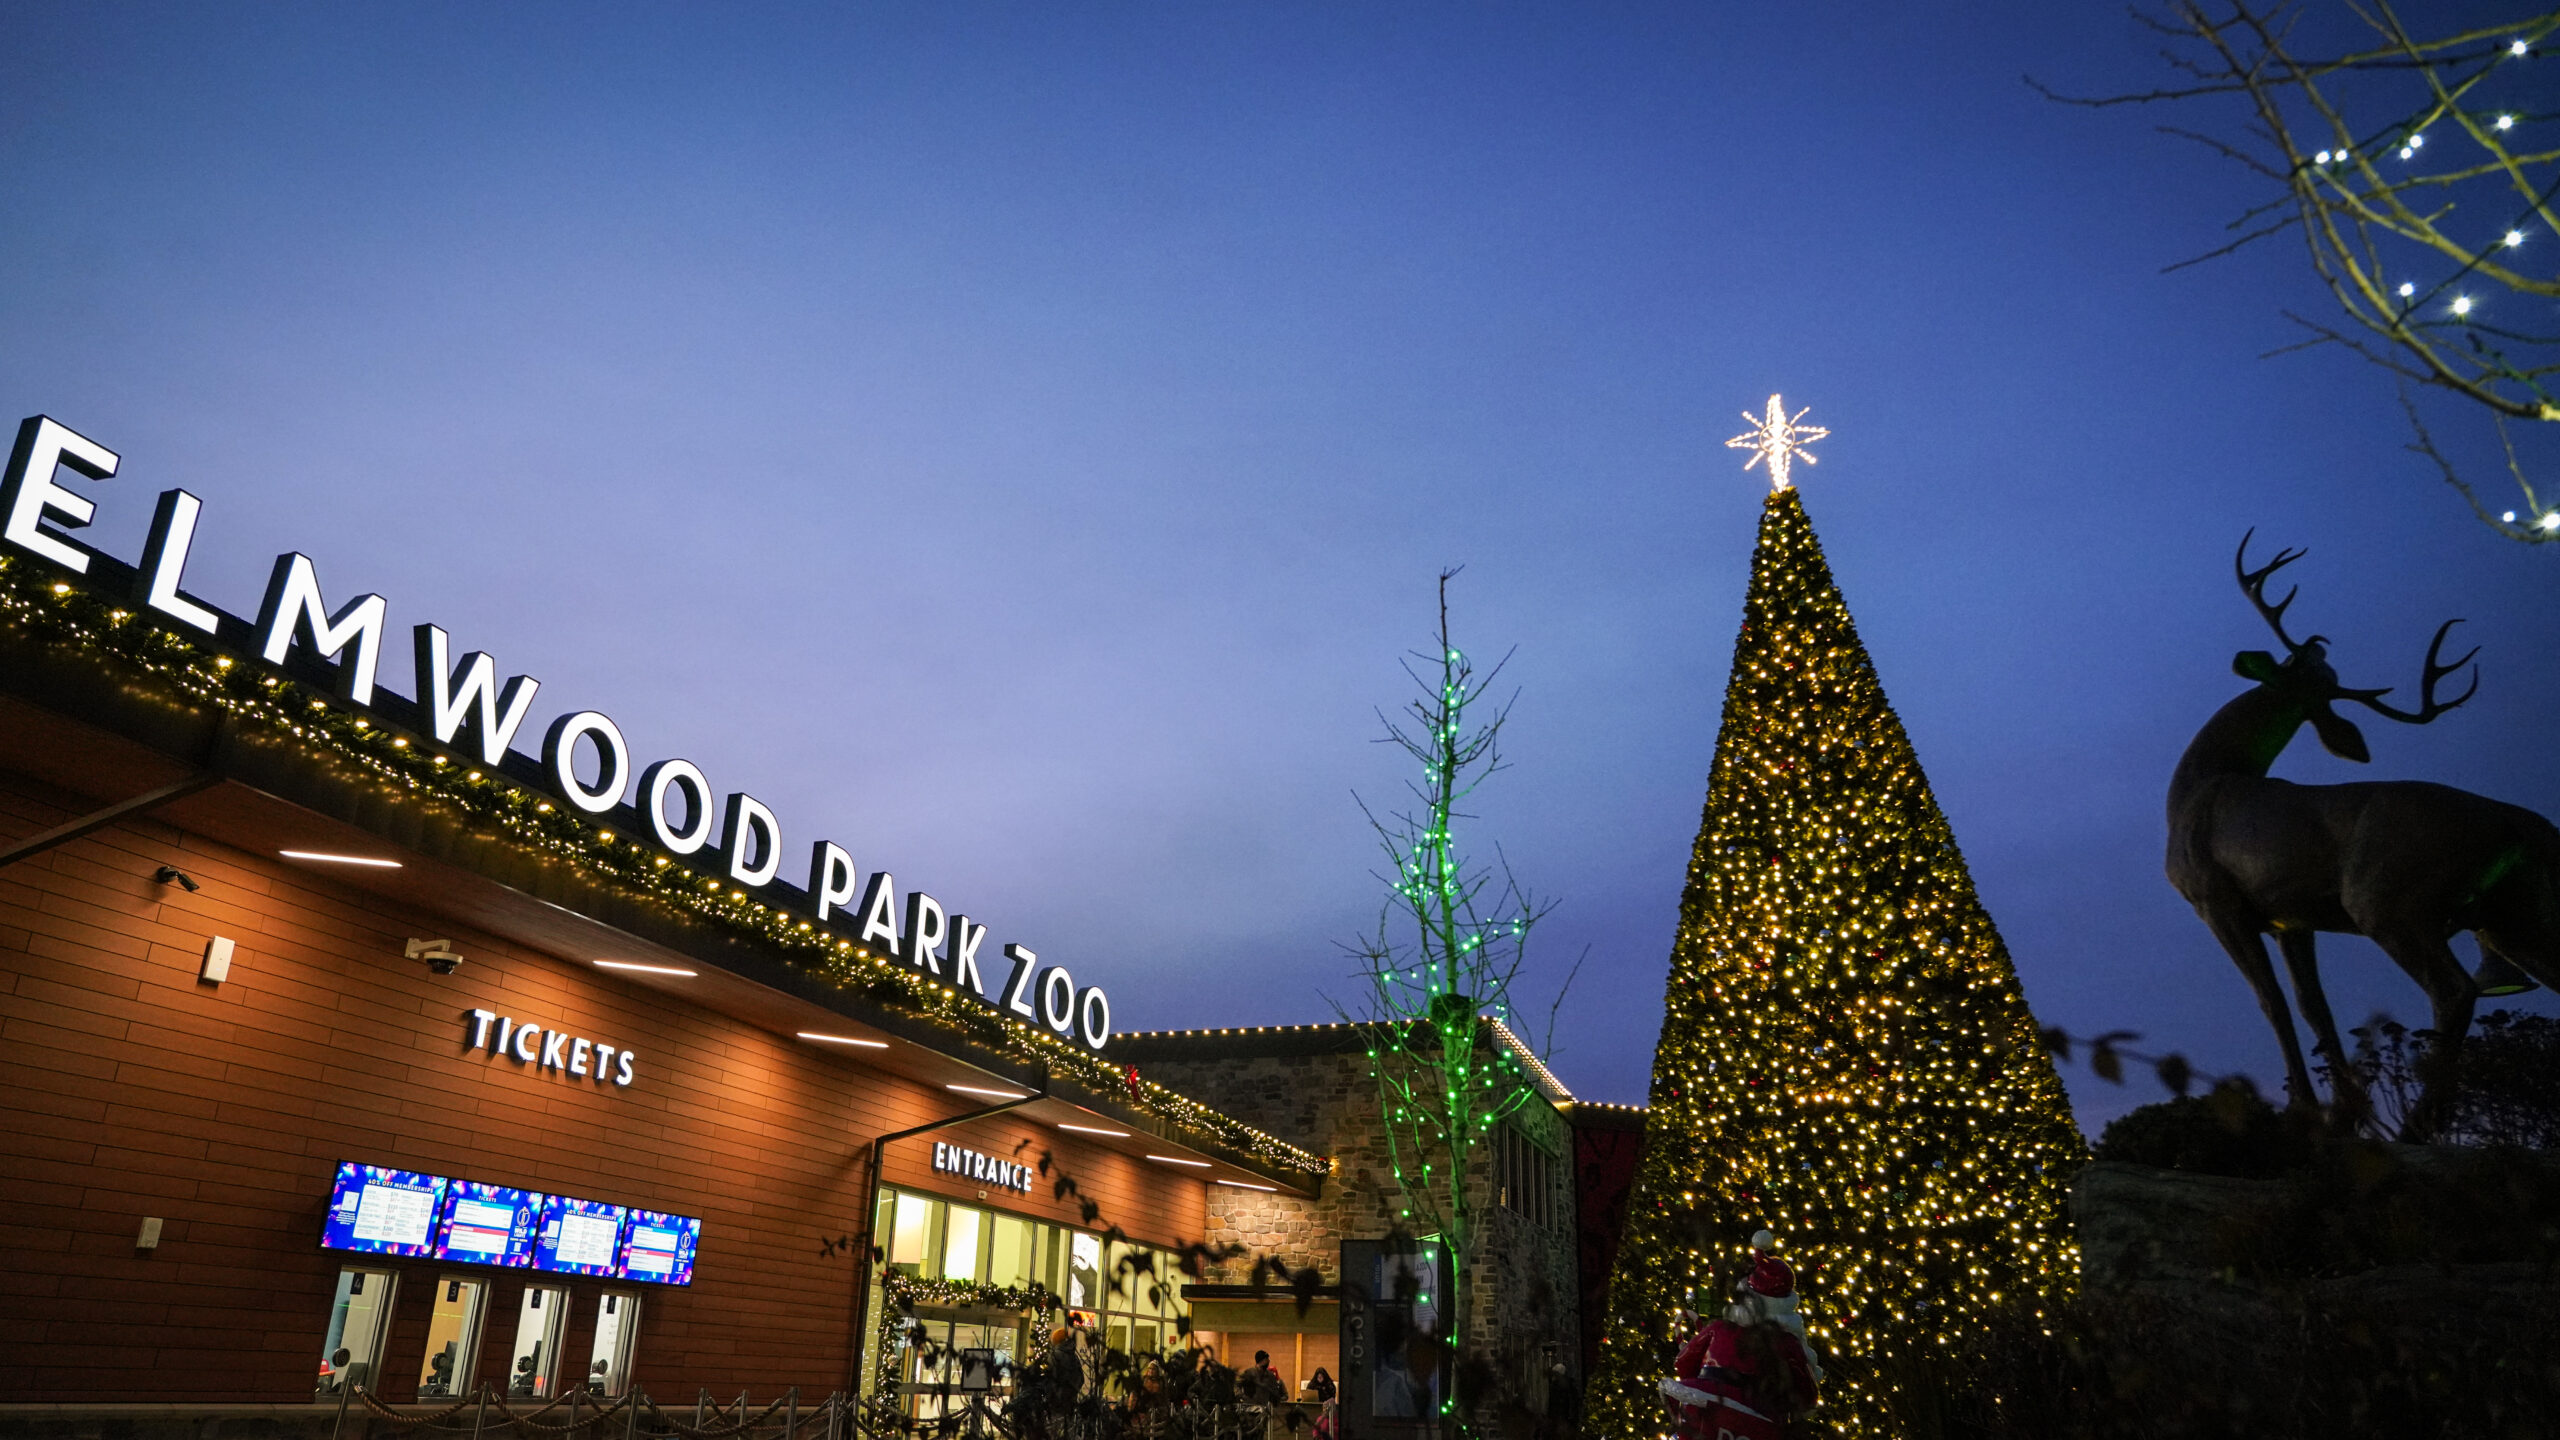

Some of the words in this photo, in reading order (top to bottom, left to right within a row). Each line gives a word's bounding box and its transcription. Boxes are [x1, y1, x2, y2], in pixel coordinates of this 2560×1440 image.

[2, 414, 782, 887] ELMWOOD
[810, 841, 988, 996] PARK
[1003, 943, 1109, 1049] ZOO
[472, 1008, 635, 1086] TICKETS
[394, 1182, 434, 1193] MEMBERSHIPS
[933, 1141, 1033, 1193] ENTRANCE
